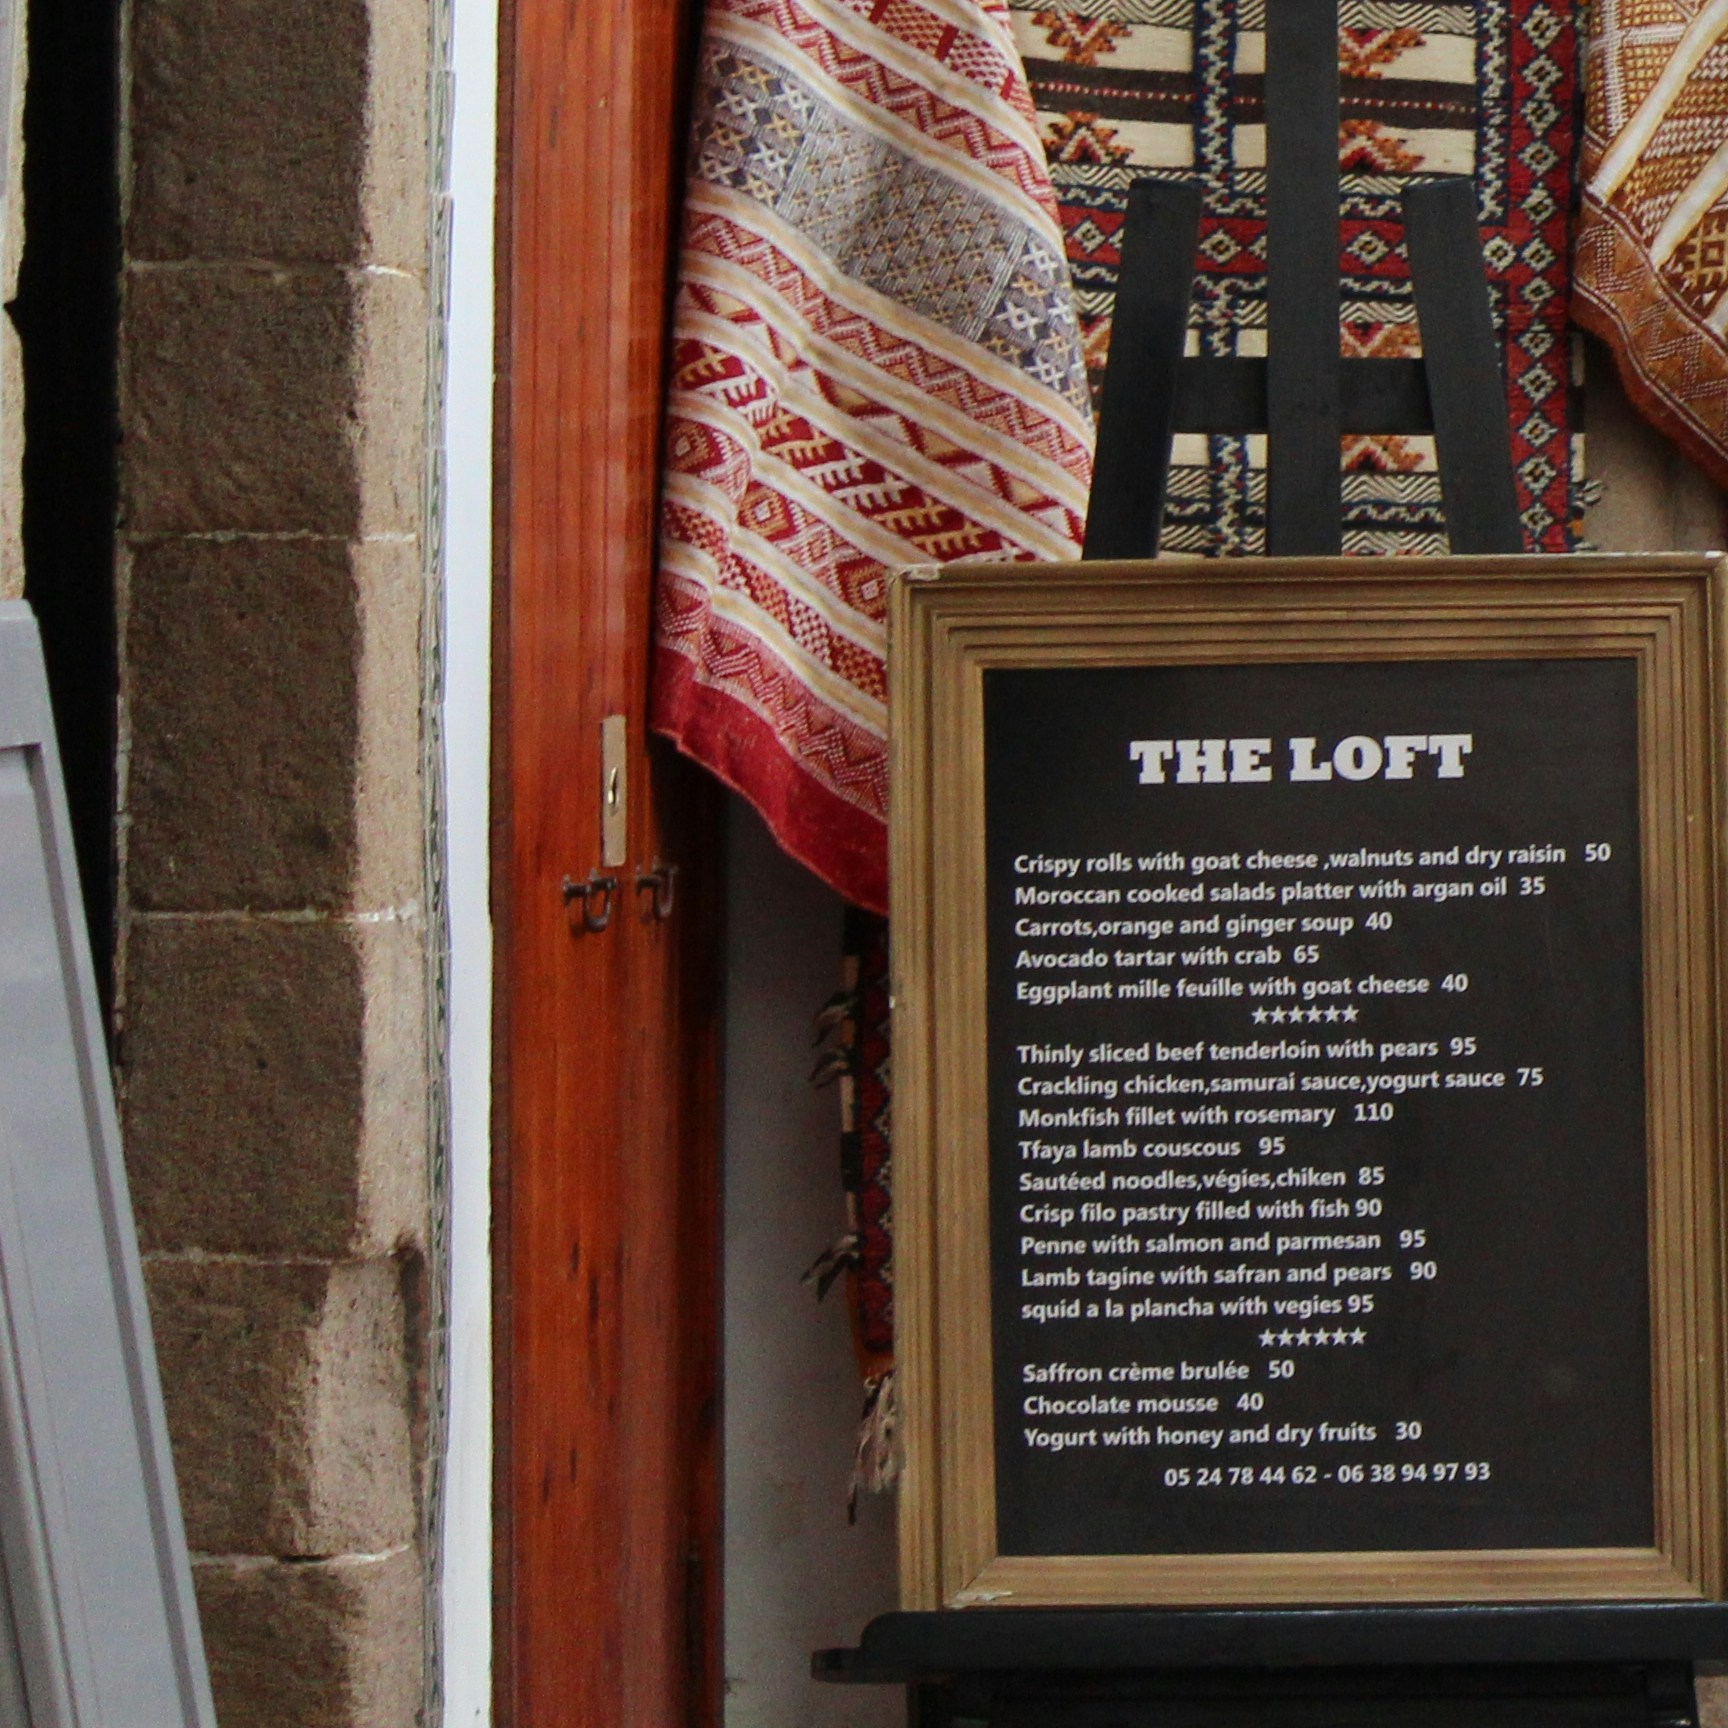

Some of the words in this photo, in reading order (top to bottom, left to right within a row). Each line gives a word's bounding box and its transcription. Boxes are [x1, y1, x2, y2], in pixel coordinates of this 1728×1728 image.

[1130, 738, 1272, 784] THE
[1289, 734, 1472, 781] LOFT
[1015, 854, 1080, 877] Crispy
[1087, 853, 1132, 872] rolls
[1138, 852, 1185, 870] with
[1191, 853, 1240, 875] goat
[1246, 850, 1318, 869] cheese
[1419, 846, 1459, 865] and
[1465, 845, 1502, 869] dry
[1508, 844, 1565, 863] raisin
[1585, 843, 1611, 862] 50
[1016, 887, 1120, 904] Moroccan
[1127, 883, 1204, 902] cooked
[1210, 882, 1275, 901] salads
[1282, 881, 1354, 905] platter
[1359, 879, 1406, 898] with
[1412, 883, 1473, 902] argan
[1480, 877, 1506, 896] oil
[1520, 876, 1545, 895] 35
[1015, 919, 1173, 939] Carrots,orange
[1180, 914, 1219, 933] and
[1226, 914, 1296, 938] ginger
[1301, 917, 1353, 936] soup
[1365, 912, 1392, 930] 40
[1016, 948, 1108, 968] Avocado
[1114, 950, 1176, 966] tartar
[1181, 946, 1228, 965] with
[1235, 945, 1281, 964] crab
[1294, 945, 1319, 963] 65
[1017, 981, 1112, 1004] Eggplant
[1119, 979, 1170, 998] mille
[1176, 978, 1243, 997] feuille
[1249, 976, 1296, 996] with
[1302, 978, 1352, 1000] goat
[1357, 975, 1429, 994] cheese
[1441, 974, 1468, 992] 40
[1019, 1107, 1119, 1127] Monkfish
[1125, 1107, 1175, 1125] fillet
[1181, 1105, 1228, 1124] with
[1235, 1108, 1335, 1127] rosemary
[1355, 1103, 1393, 1121] 110
[1020, 1171, 1105, 1191] Sautéed
[1112, 1167, 1346, 1193] noodles,végies,chiken
[1359, 1167, 1384, 1185] 85
[1023, 1363, 1102, 1382] Saffron
[1109, 1362, 1174, 1381] crème
[1181, 1360, 1249, 1380] brulée
[1269, 1360, 1294, 1378] 50
[1024, 1395, 1130, 1414] Chocolate
[1137, 1398, 1218, 1413] mousse
[1237, 1393, 1263, 1411] 40
